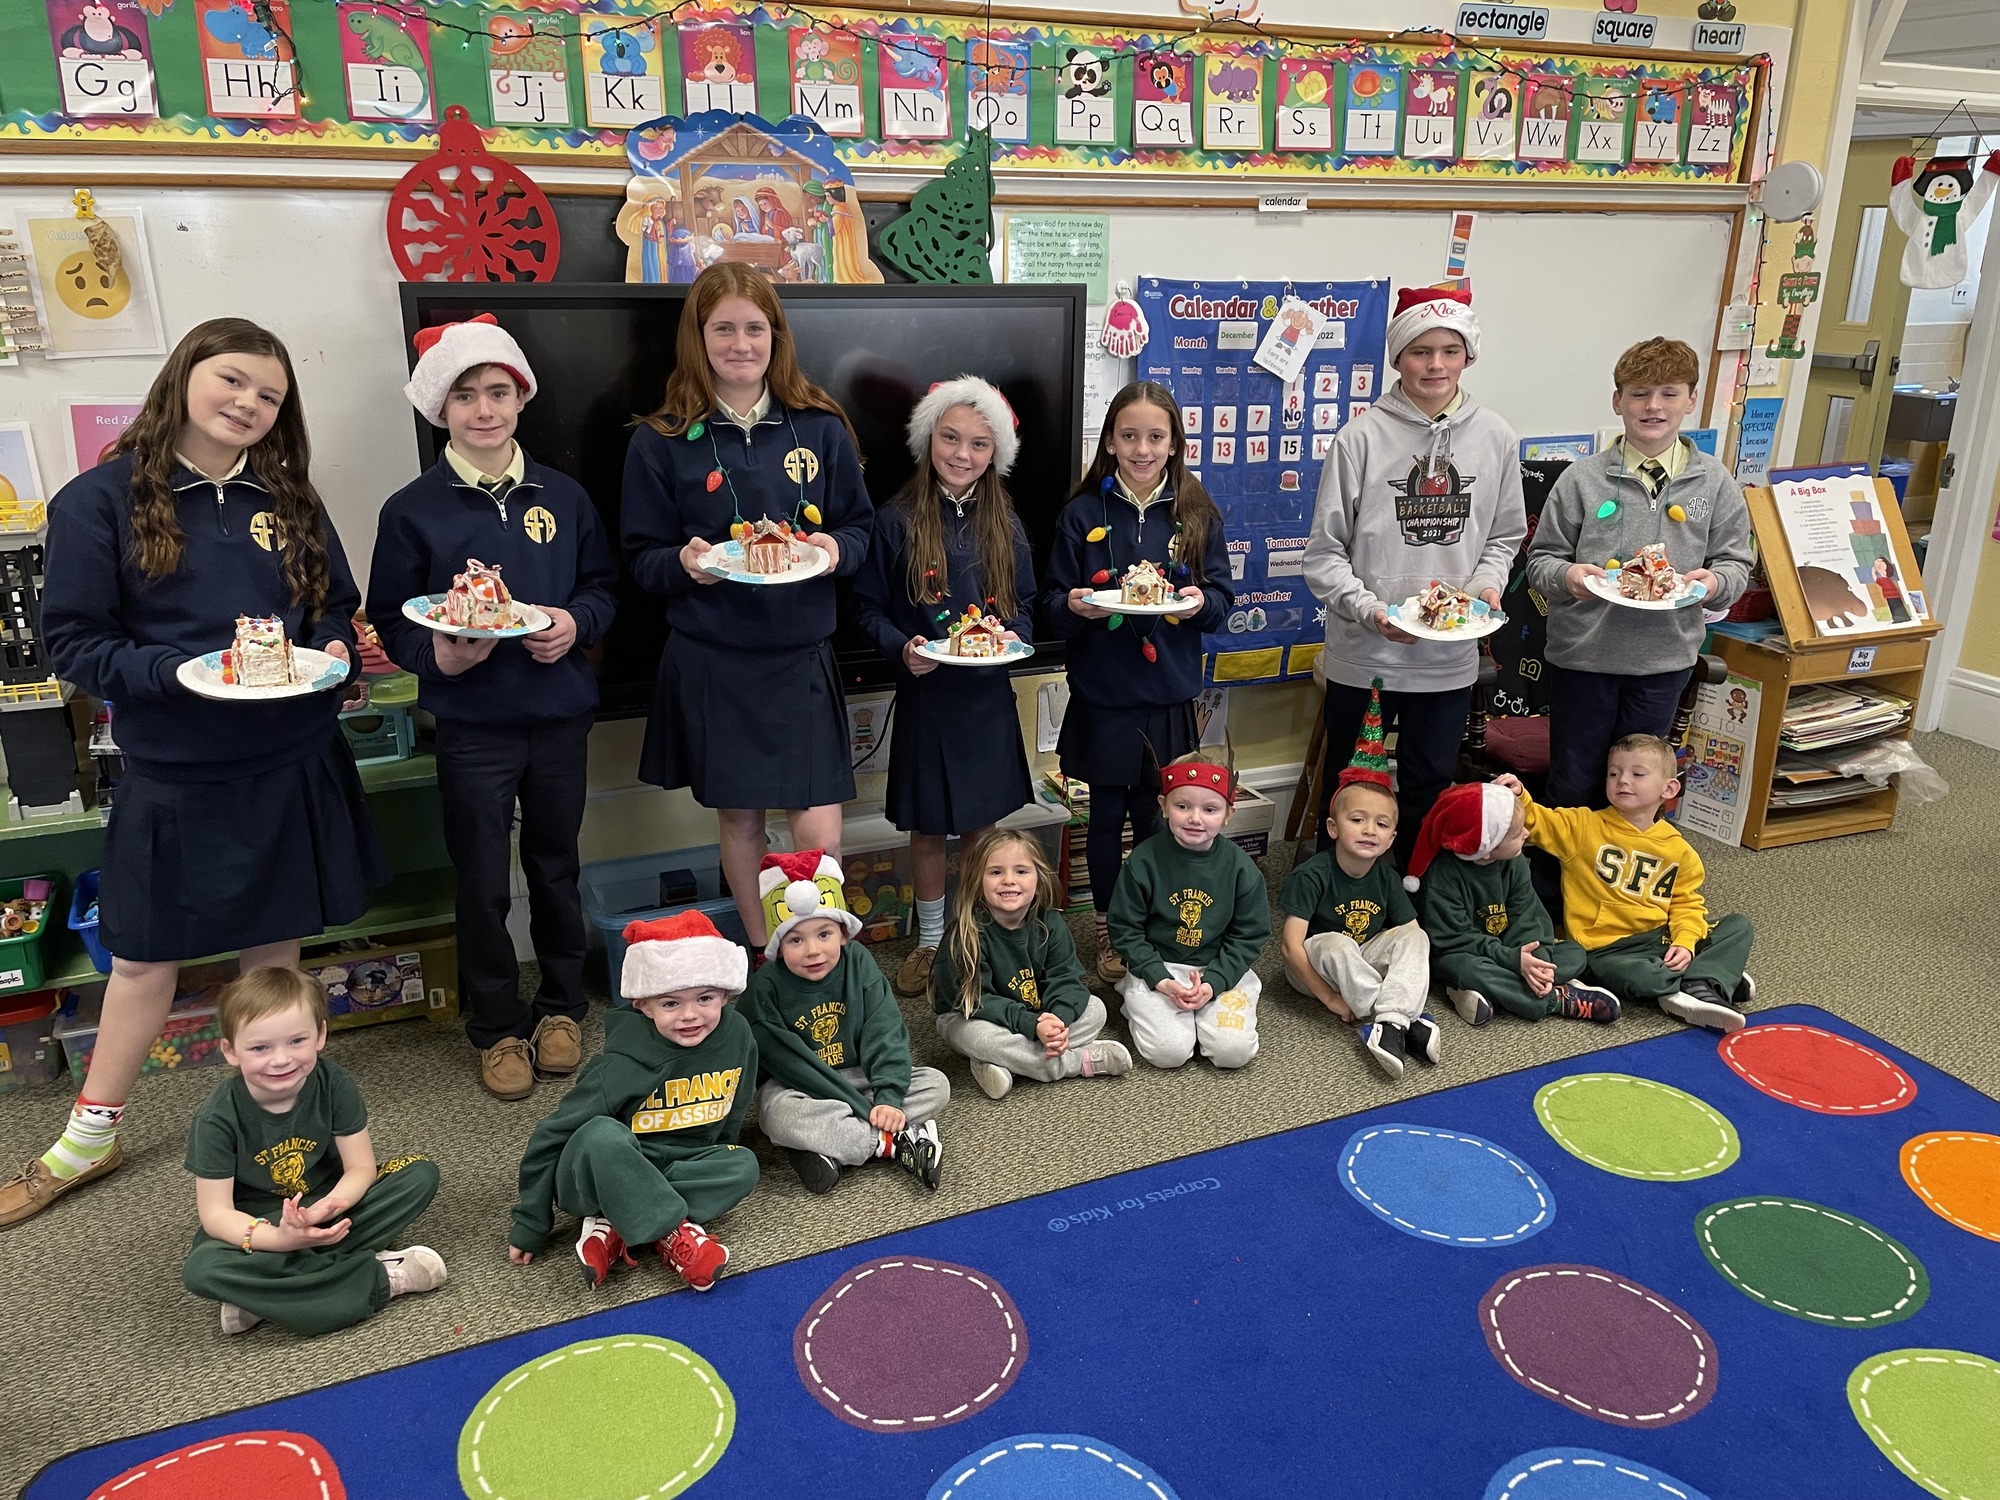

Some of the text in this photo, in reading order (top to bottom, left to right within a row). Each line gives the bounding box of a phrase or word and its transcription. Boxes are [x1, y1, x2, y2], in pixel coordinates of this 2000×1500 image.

[537, 15, 560, 25] jellyfish
[1459, 10, 1545, 35] rectangle
[1597, 18, 1653, 42] square
[1698, 26, 1742, 46] heart
[74, 62, 137, 113] Gg
[223, 63, 276, 98] Hh
[375, 69, 400, 102] Ii
[514, 76, 545, 122] Jj
[604, 78, 645, 110] Kk
[800, 87, 853, 118] Mm
[894, 92, 934, 122] Nn
[977, 96, 1017, 125] Oo
[1070, 100, 1101, 140] Pp
[1141, 105, 1186, 143] Qq
[1219, 107, 1245, 133] Rr
[1292, 110, 1316, 135] Ss
[1360, 113, 1381, 139] Tt
[1414, 119, 1442, 144] Uu
[1477, 121, 1503, 145] Vv
[1526, 121, 1562, 147] Ww
[1586, 125, 1612, 149] Xx
[1646, 125, 1667, 158] Yy
[1697, 128, 1721, 152] Zz
[1265, 196, 1301, 207] calendar
[1048, 261, 1064, 269] happy
[1066, 261, 1083, 269] things
[1069, 271, 1085, 279] happy
[1169, 294, 1258, 320] Calendar
[1174, 336, 1208, 349] Month
[1221, 331, 1254, 339] December
[1321, 378, 1331, 392] 2
[1357, 377, 1366, 391] 3
[1290, 396, 1298, 409] 8
[96, 416, 119, 425] Red
[1188, 412, 1196, 427] 5
[1219, 413, 1229, 428] 6
[1255, 411, 1264, 425] 7
[1284, 409, 1301, 422] No
[1321, 410, 1330, 425] 9
[1743, 422, 1776, 432] SPECIAL
[1250, 441, 1265, 456] 14
[1284, 440, 1298, 455] 15
[1745, 436, 1768, 446] because
[1186, 444, 1198, 459] 12
[1217, 442, 1231, 457] 13
[1790, 486, 1827, 497] A Big Box
[1399, 503, 1467, 517] BASKETBALL
[1407, 517, 1460, 528] CHAMPIONSHIP
[1422, 529, 1441, 538] 2021
[1270, 559, 1302, 568] Wednesda
[1251, 590, 1292, 603] Weather
[1858, 651, 1869, 659] Big
[1594, 844, 1679, 902] SFA
[1169, 888, 1214, 908] ST. FRANCIS
[1334, 899, 1381, 915] ST. FRANCIS
[1176, 926, 1202, 939] GOLDEN
[1175, 935, 1201, 948] BEARS
[1007, 976, 1021, 991] ST.
[794, 1001, 847, 1031] ST. FRANCIS
[815, 1042, 843, 1059] OLDEN
[638, 1113, 665, 1130] OF
[254, 1137, 318, 1166] ST FRANCIS
[1145, 1177, 1221, 1203] Carpets
[1117, 1197, 1146, 1212] for
